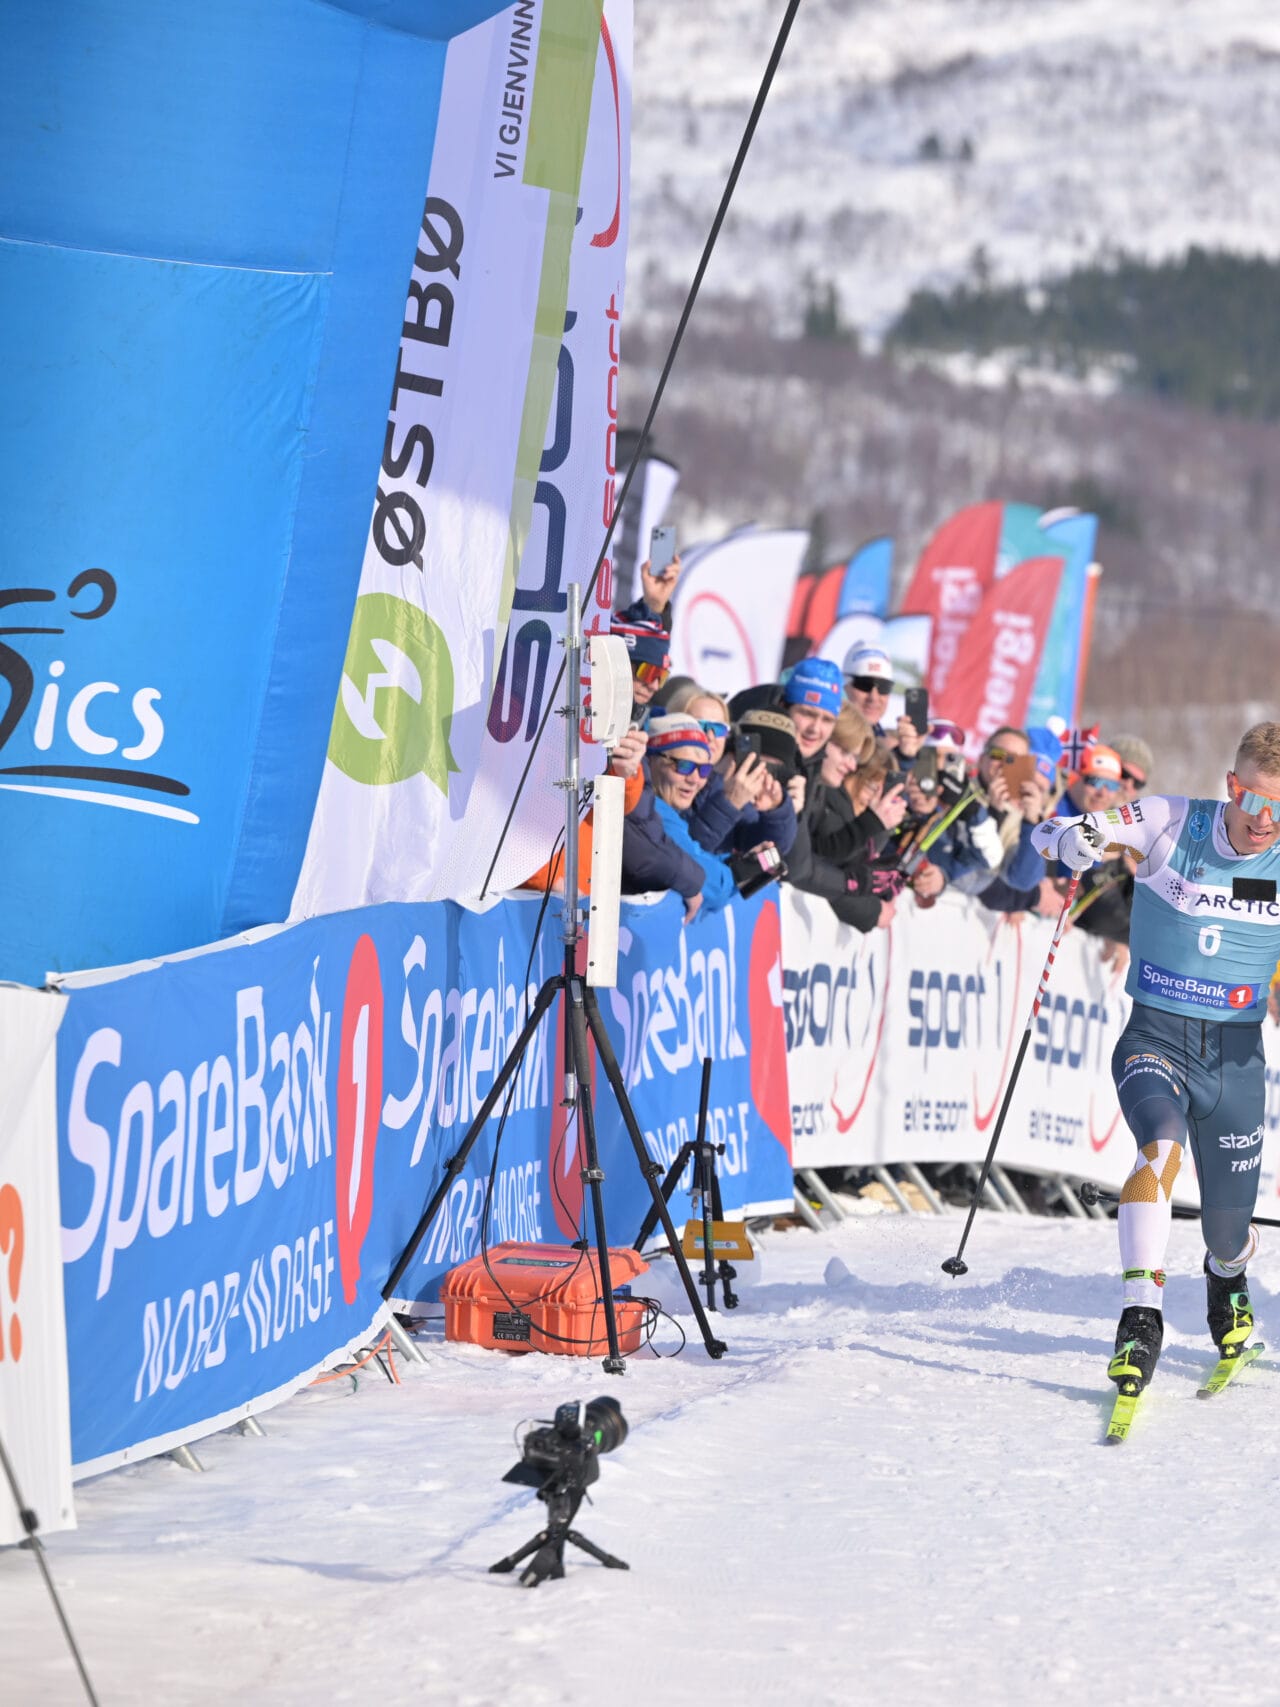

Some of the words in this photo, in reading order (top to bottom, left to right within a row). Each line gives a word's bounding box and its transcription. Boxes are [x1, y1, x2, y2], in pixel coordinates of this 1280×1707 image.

[494, 152, 517, 178] VI
[1195, 893, 1280, 917] ARCTIC
[1198, 924, 1224, 957] 6
[1143, 964, 1227, 998] SpareBank
[1236, 989, 1246, 1004] 1
[1161, 987, 1225, 1007] NORD-NORGE
[908, 961, 986, 1073] sport
[59, 956, 332, 1300] SpareBank
[348, 1004, 369, 1232] 1
[134, 1219, 335, 1402] NORD-NORGE
